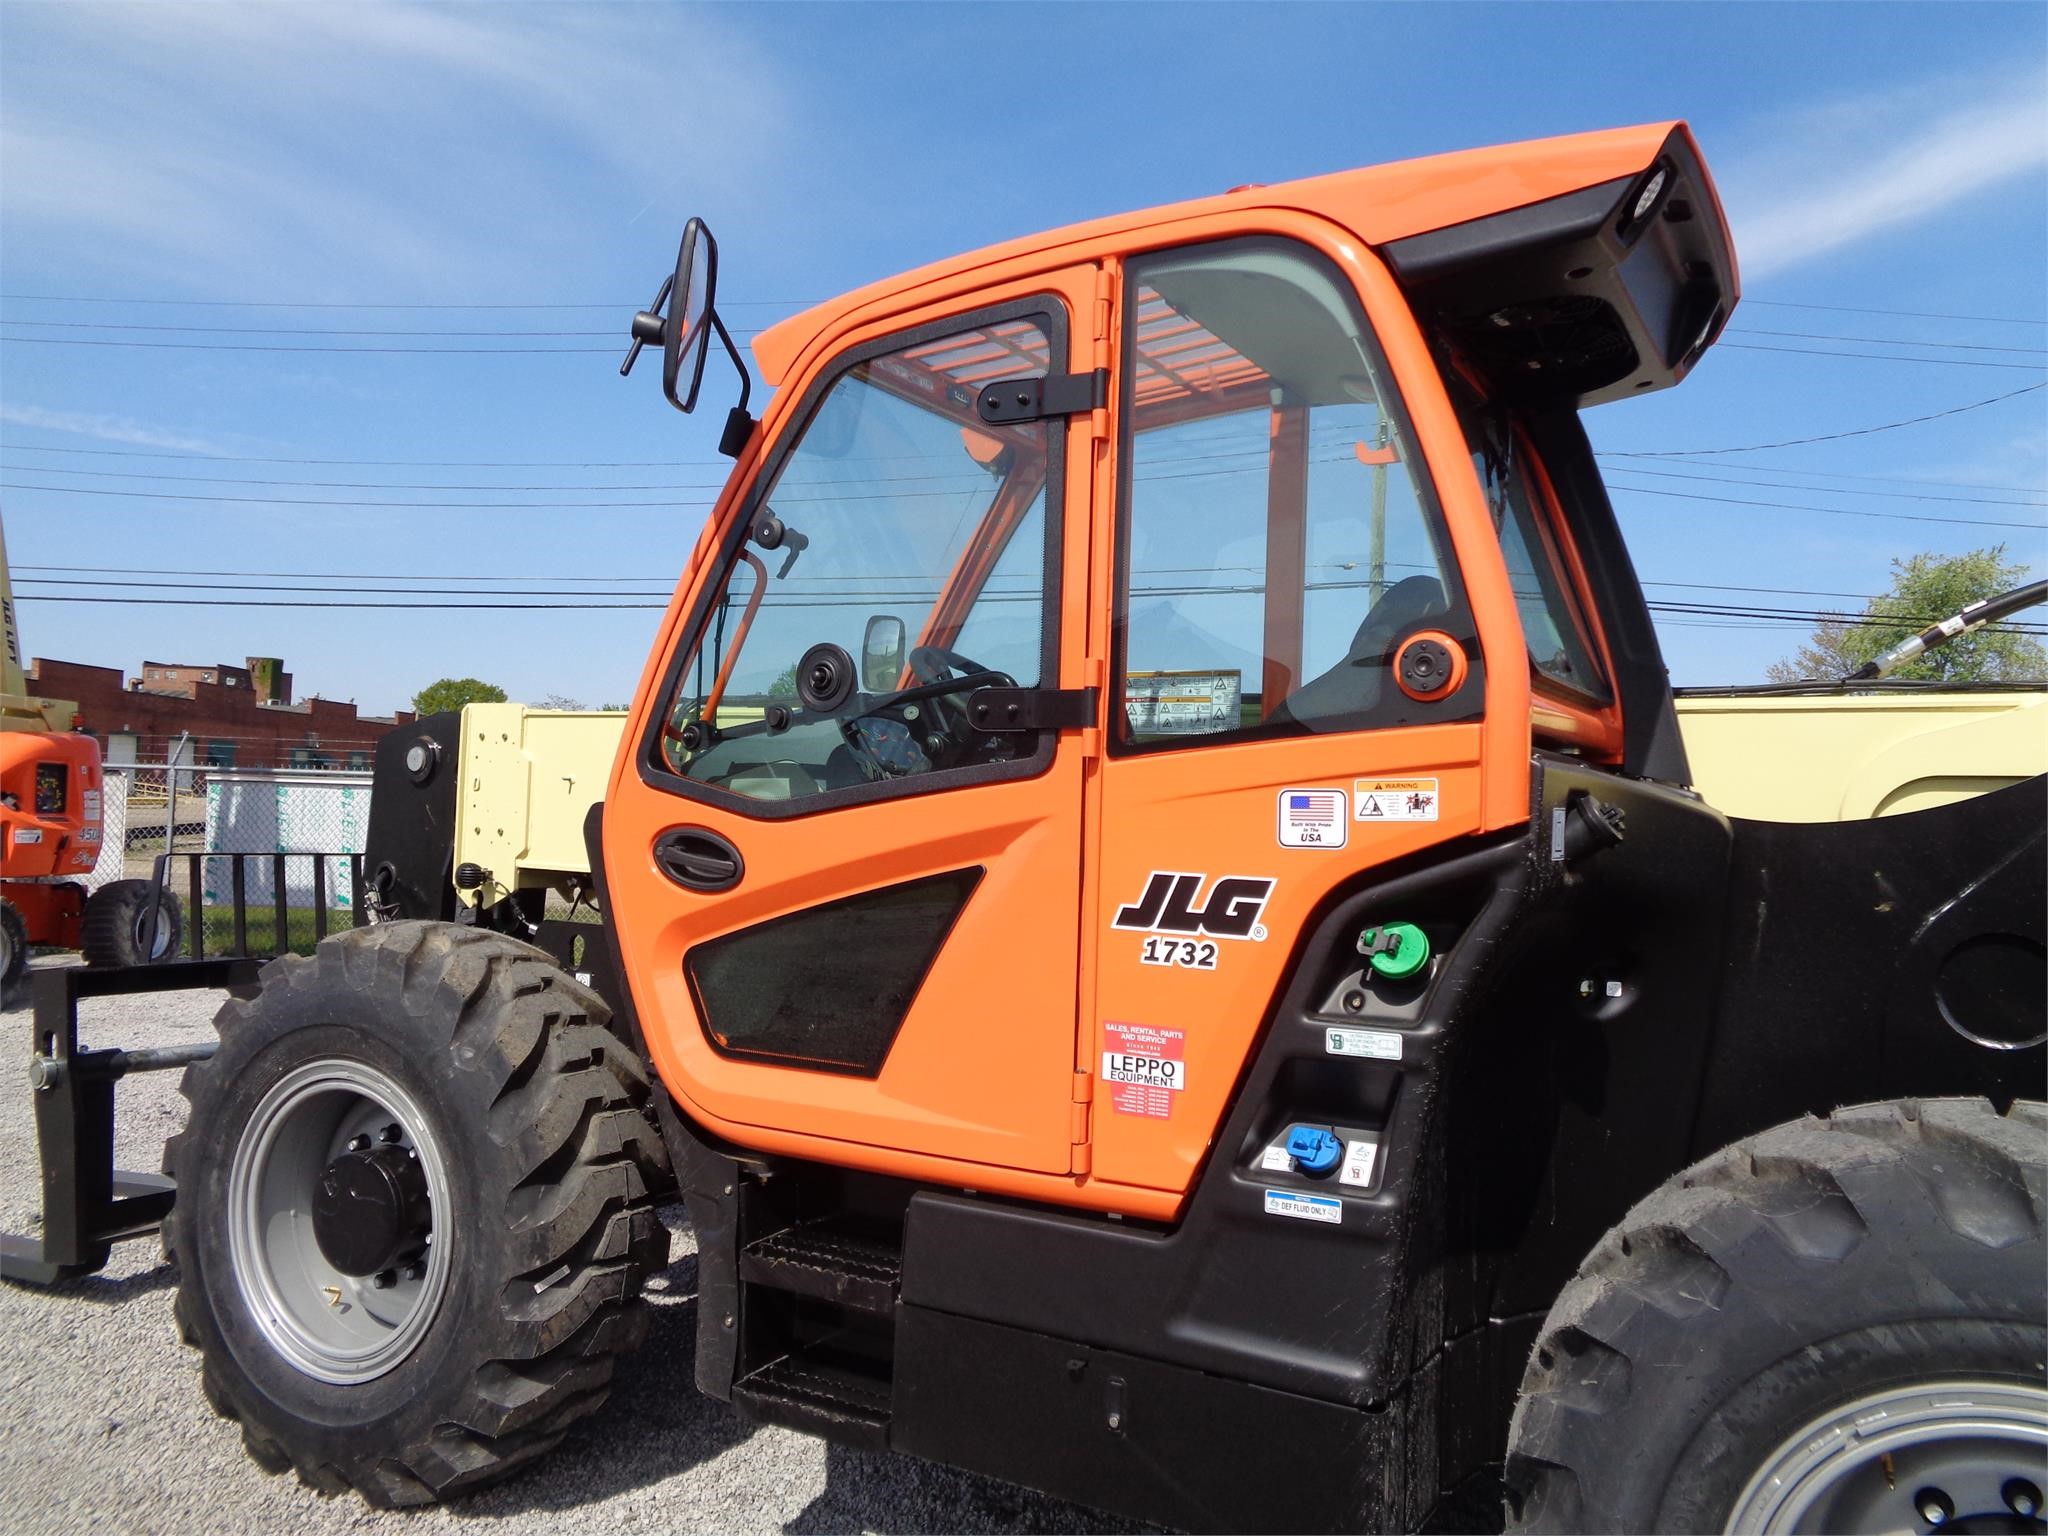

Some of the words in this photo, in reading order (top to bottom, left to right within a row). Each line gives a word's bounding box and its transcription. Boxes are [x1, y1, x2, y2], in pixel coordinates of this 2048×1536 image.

[1300, 833, 1322, 842] USA
[1114, 873, 1273, 937] JLG
[1143, 938, 1216, 967] 1732
[1105, 1023, 1130, 1033] SALES,
[1130, 1026, 1160, 1037] RENTAL,
[1160, 1030, 1183, 1039] PARTS
[1120, 1033, 1136, 1041] AND
[1136, 1034, 1167, 1045] SERVICE
[1110, 1054, 1175, 1077] LEPPO
[1281, 1202, 1292, 1210] DEF
[1293, 1204, 1310, 1213] FLUID
[1311, 1206, 1327, 1216] ONLY
